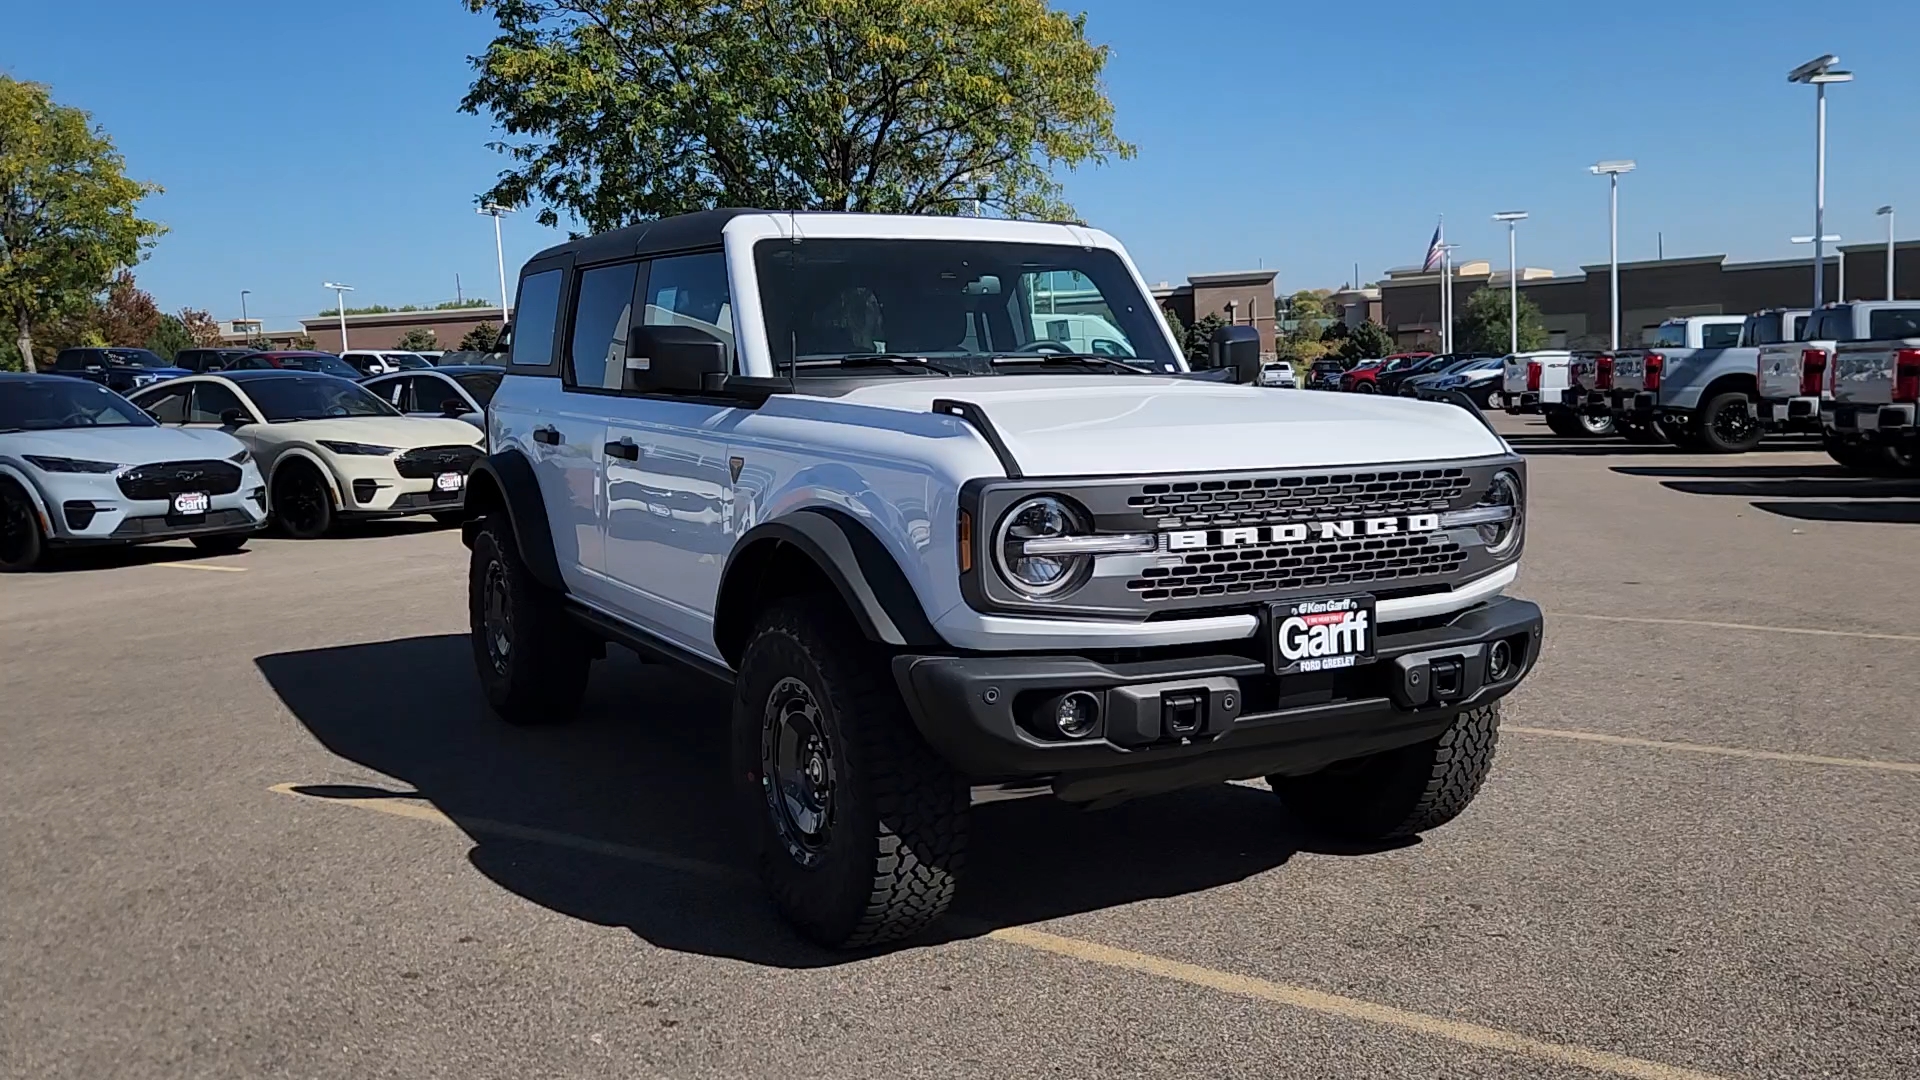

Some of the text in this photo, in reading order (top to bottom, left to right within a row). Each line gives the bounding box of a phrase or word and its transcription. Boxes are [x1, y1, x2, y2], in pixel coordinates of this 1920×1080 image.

[175, 495, 208, 511] Garff
[1168, 513, 1442, 550] BRONCO
[1307, 598, 1350, 613] Ken Garff
[1279, 610, 1368, 660] Garff
[1300, 655, 1356, 672] FORD GREELEY
